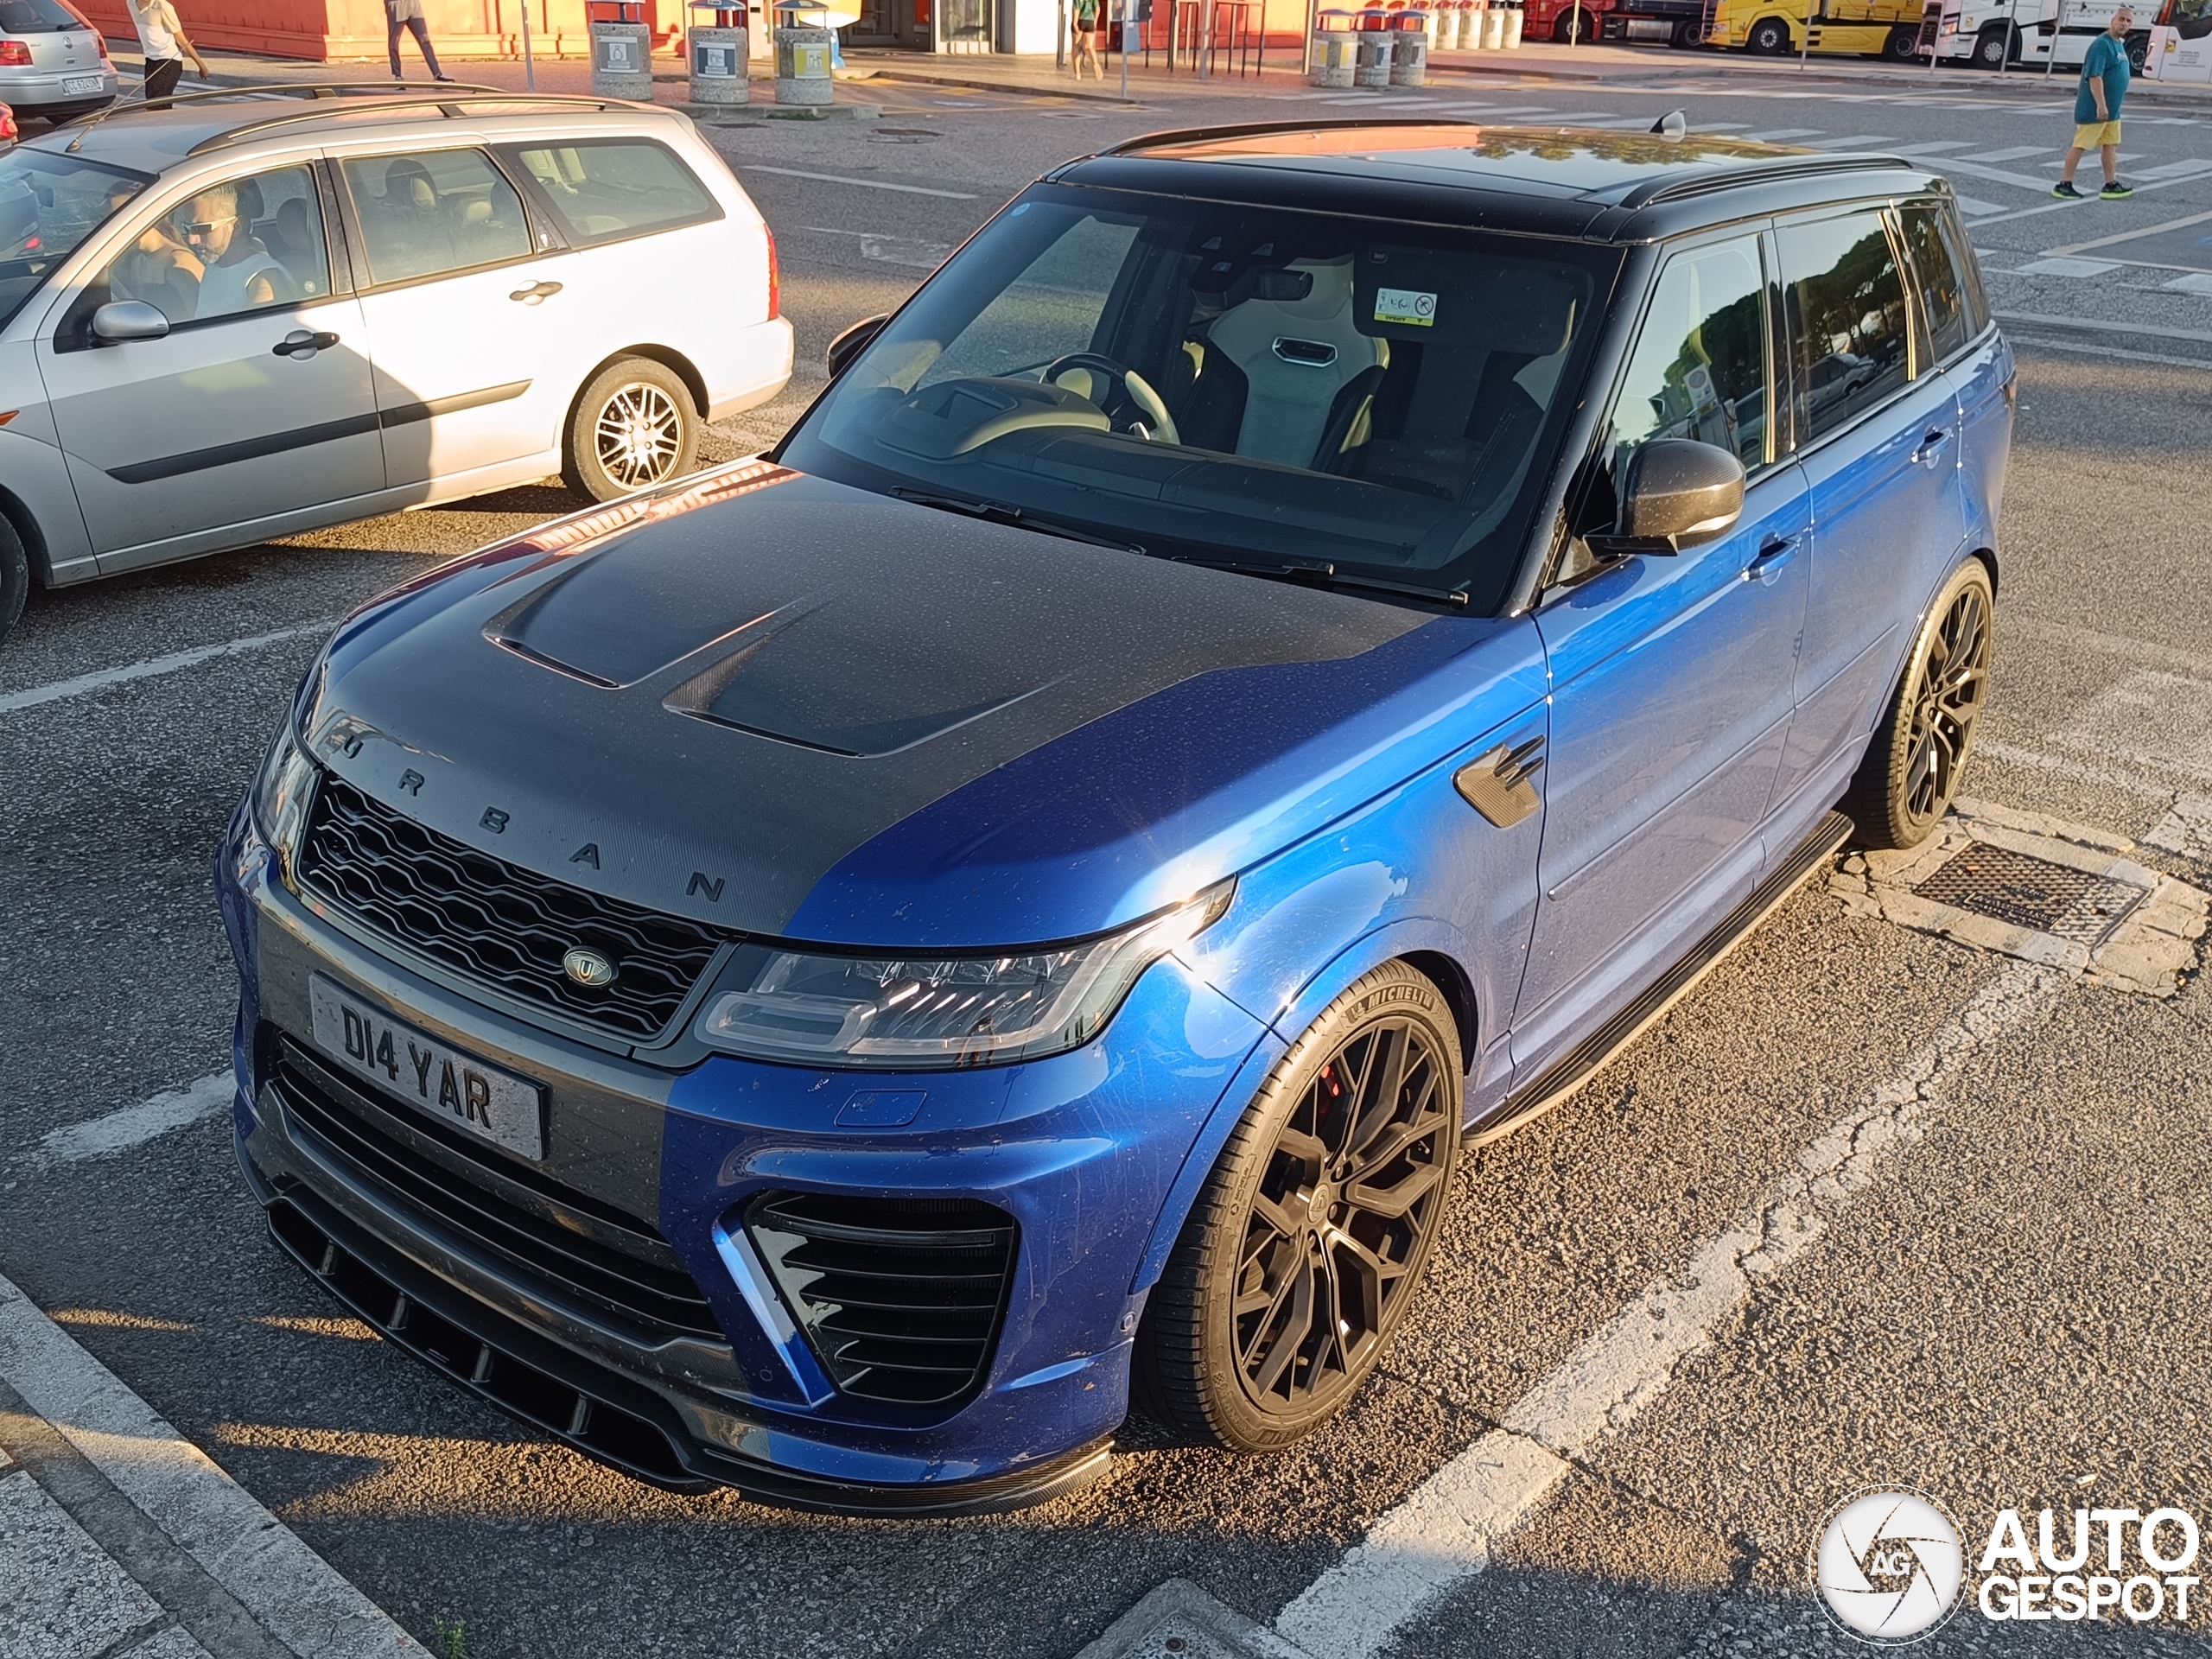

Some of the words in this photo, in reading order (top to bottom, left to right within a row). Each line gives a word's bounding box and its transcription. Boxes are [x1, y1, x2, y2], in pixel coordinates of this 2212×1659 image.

[1896, 702, 1912, 785] MICHELIN
[340, 735, 725, 902] URBAN
[580, 960, 593, 977] U
[1368, 986, 1433, 1009] MICHELIN
[340, 1004, 399, 1082] D14
[407, 1039, 493, 1130] YAR
[1235, 1166, 1249, 1201] MICHELIN
